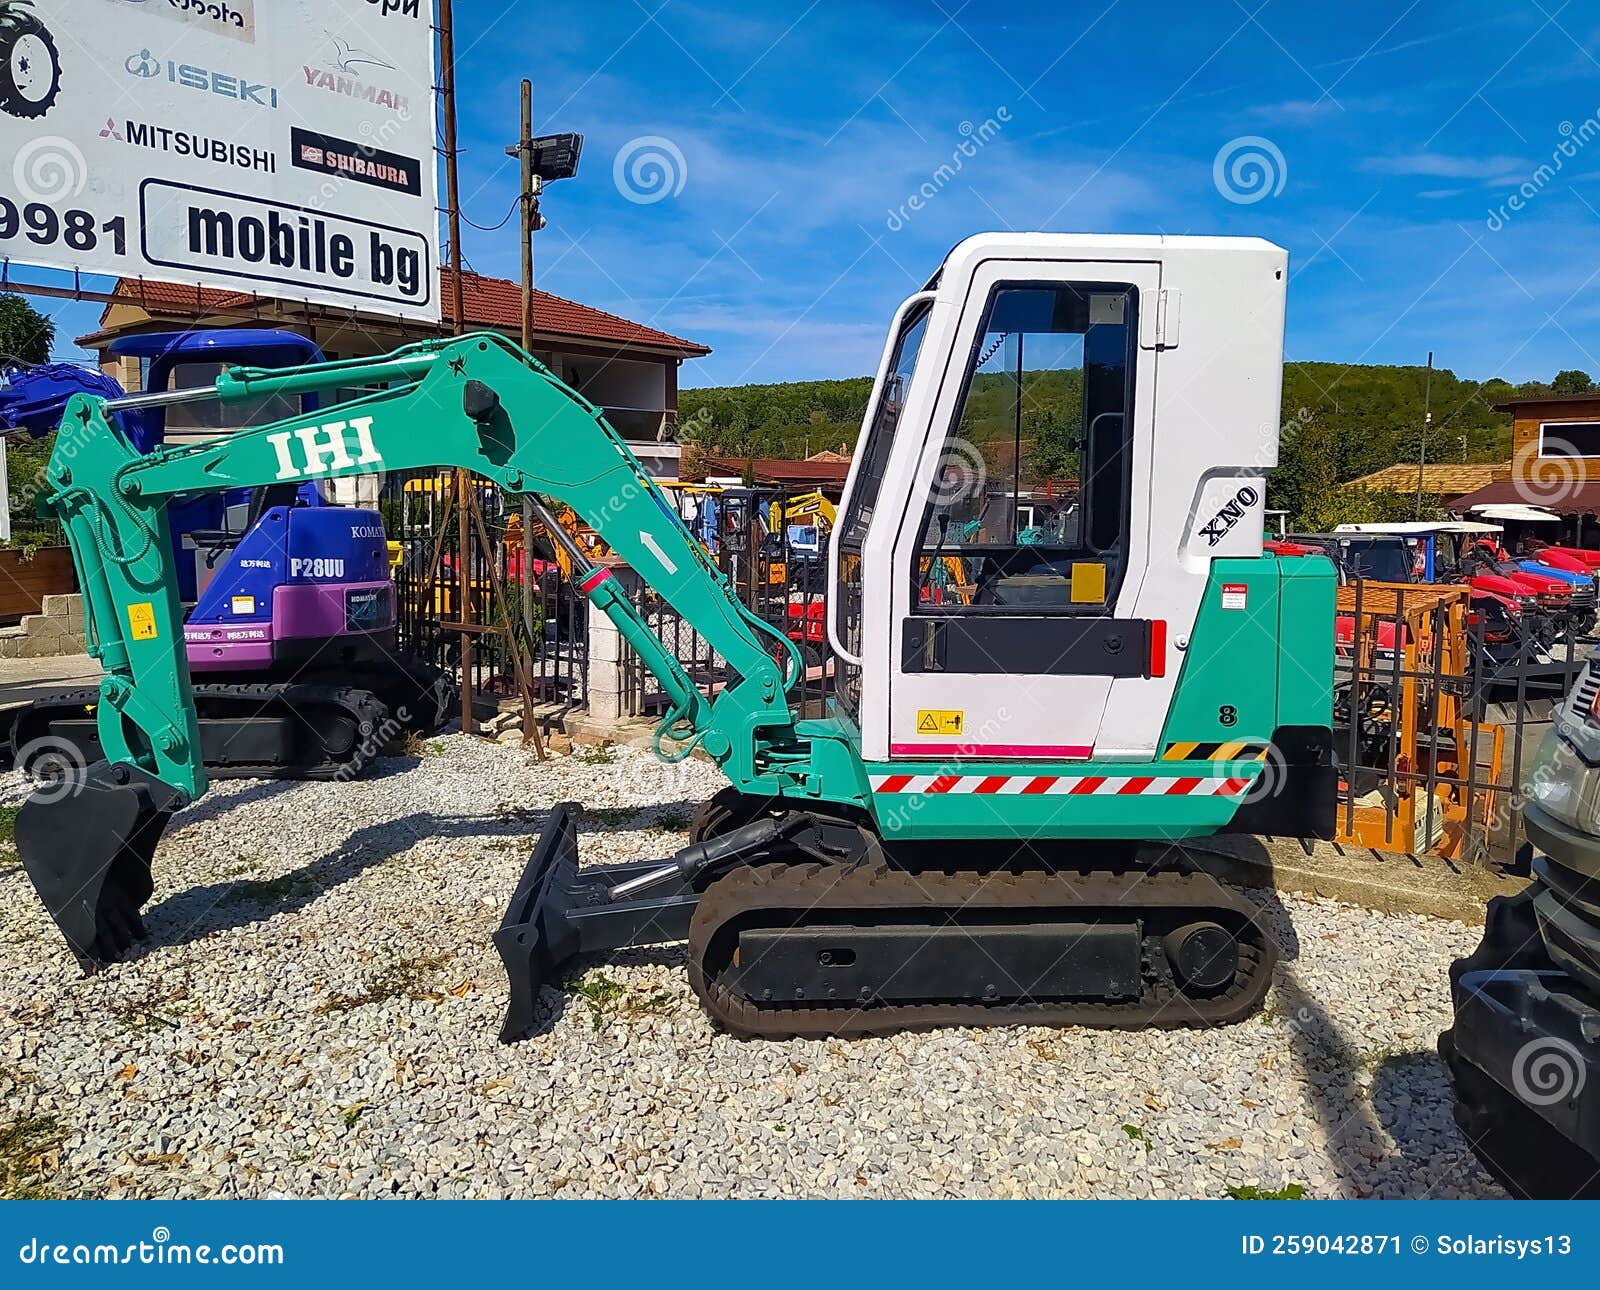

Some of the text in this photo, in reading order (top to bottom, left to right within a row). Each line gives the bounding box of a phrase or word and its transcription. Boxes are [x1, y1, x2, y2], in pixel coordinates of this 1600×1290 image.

[167, 60, 279, 108] ISEKI
[303, 65, 409, 112] YANMAR
[126, 120, 276, 174] MITSUBISHI
[326, 150, 409, 186] SHIBAURA
[0, 196, 126, 256] 9981
[188, 206, 419, 296] mobile bg
[267, 416, 383, 480] IHI
[1198, 485, 1259, 547] XNO
[291, 557, 345, 578] P28UU
[1219, 705, 1238, 727] 8
